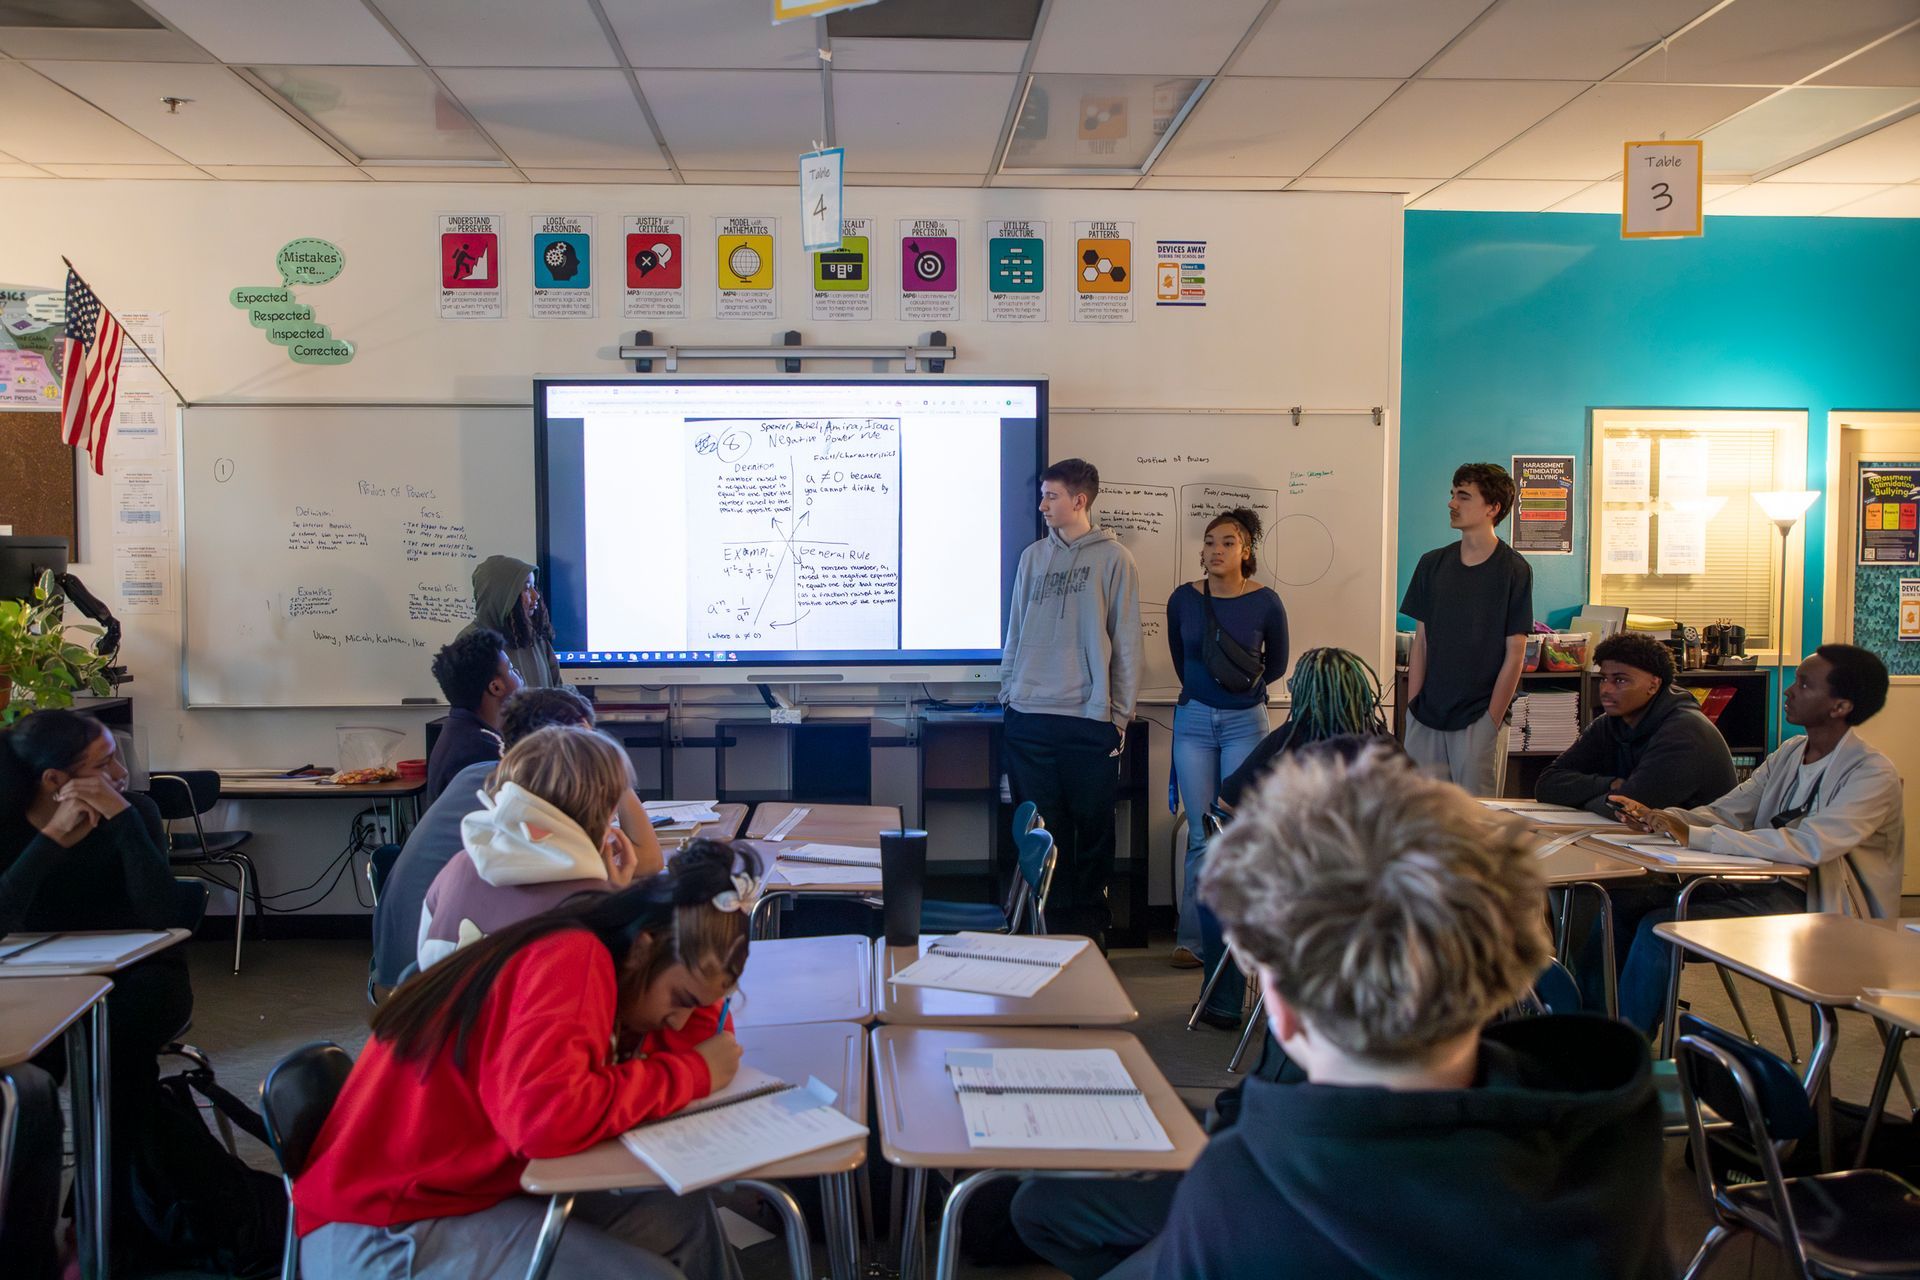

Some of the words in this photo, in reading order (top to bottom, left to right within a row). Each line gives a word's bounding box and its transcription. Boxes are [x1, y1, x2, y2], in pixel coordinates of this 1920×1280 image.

[1644, 155, 1682, 168] Table
[809, 167, 831, 180] Table
[1651, 182, 1673, 211] 3
[813, 193, 827, 221] 4
[284, 252, 337, 263] Mistakes
[296, 266, 325, 274] are...
[237, 292, 288, 304] Expected
[254, 310, 311, 322] Respected
[272, 328, 325, 340] Inspected
[294, 345, 349, 356] Corrected
[864, 420, 895, 431] Isaac
[769, 434, 816, 448] Negative
[850, 472, 882, 480] because
[1868, 475, 1912, 484] Harassment
[804, 488, 817, 496] you
[820, 484, 848, 493] cannot
[852, 484, 875, 493] divide
[881, 483, 889, 495] by
[1871, 480, 1916, 490] Intimidation
[1875, 487, 1910, 498] Bullying
[800, 546, 845, 560] General
[849, 550, 871, 560] Rule
[801, 563, 815, 574] Any
[840, 573, 868, 582] negative
